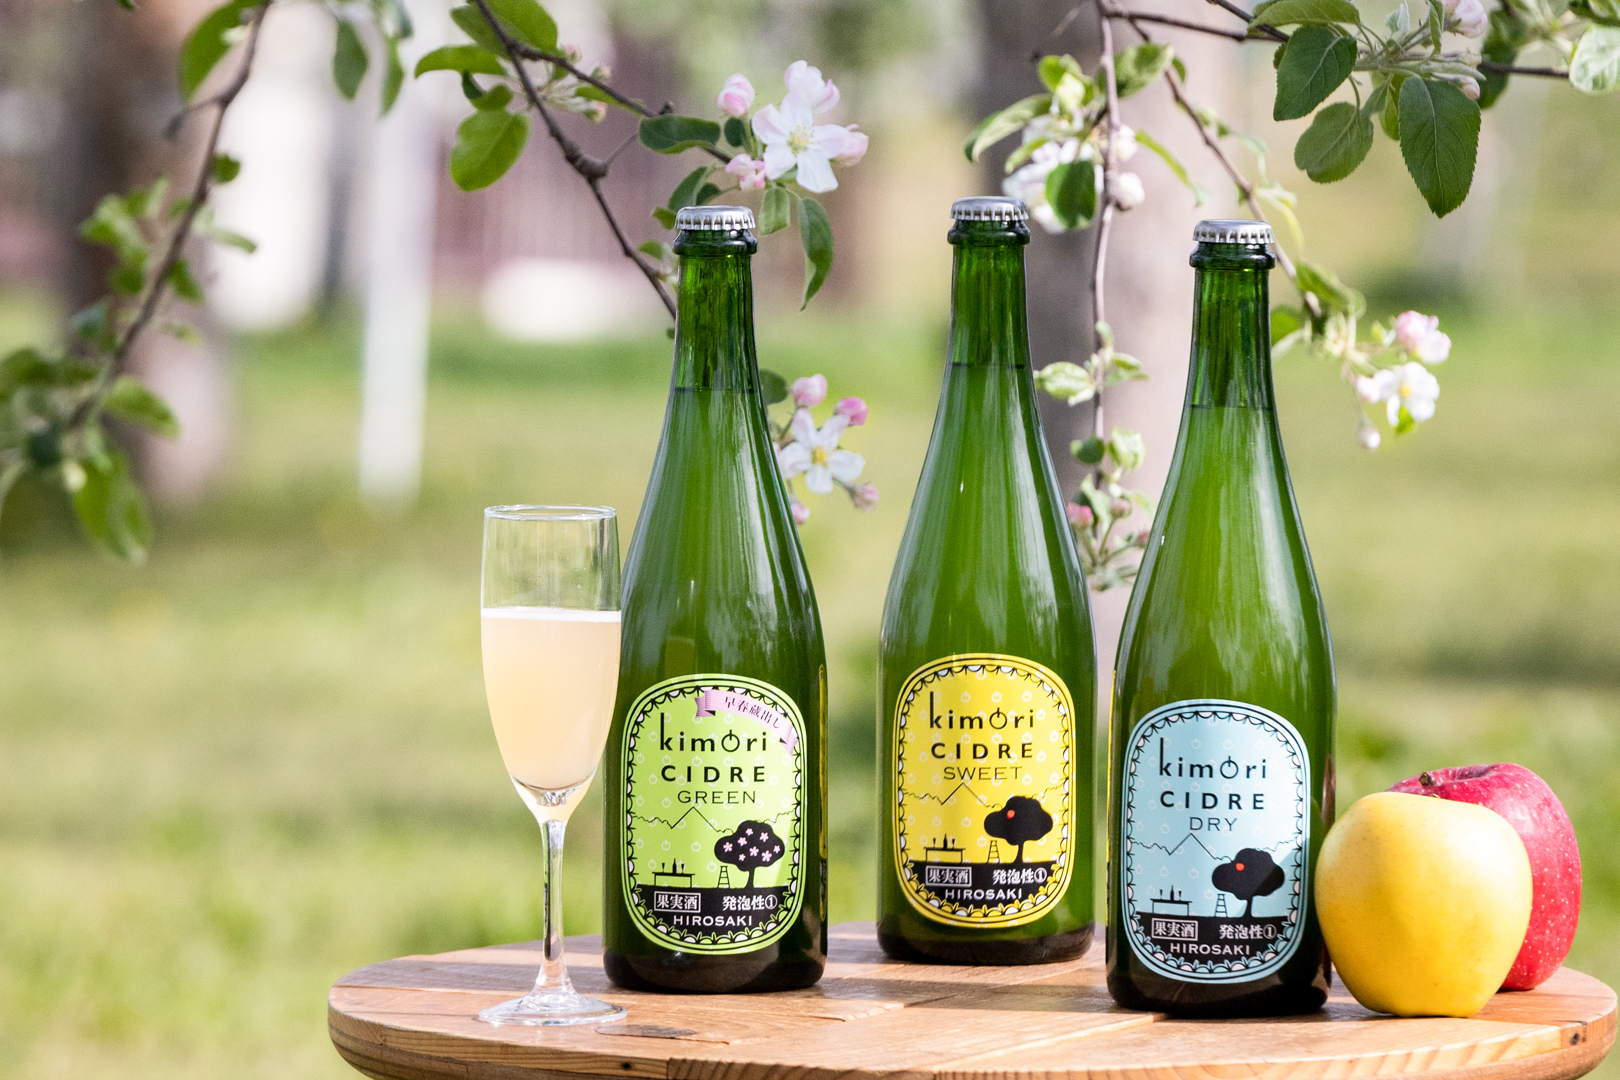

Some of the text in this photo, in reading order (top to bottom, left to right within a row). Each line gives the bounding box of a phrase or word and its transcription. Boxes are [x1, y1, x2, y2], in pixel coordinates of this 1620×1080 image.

[724, 696, 781, 729] 早春蔵出し
[929, 691, 1034, 729] kimori
[660, 712, 767, 752] kimori
[931, 742, 1033, 760] CIDRE
[1159, 737, 1266, 779] kimori
[661, 765, 766, 782] CIDRE
[943, 766, 1023, 780] SWEET
[677, 790, 756, 804] GREEN
[1160, 790, 1265, 810] CIDRE
[1189, 816, 1237, 831] DRY
[928, 868, 969, 884] 果実酒
[656, 894, 698, 911] 果実酒
[945, 888, 1023, 901] HIROSAKI
[673, 915, 753, 927] HIROSAKI
[1154, 921, 1195, 938] 果実酒
[1170, 942, 1251, 955] HIROSAKI
